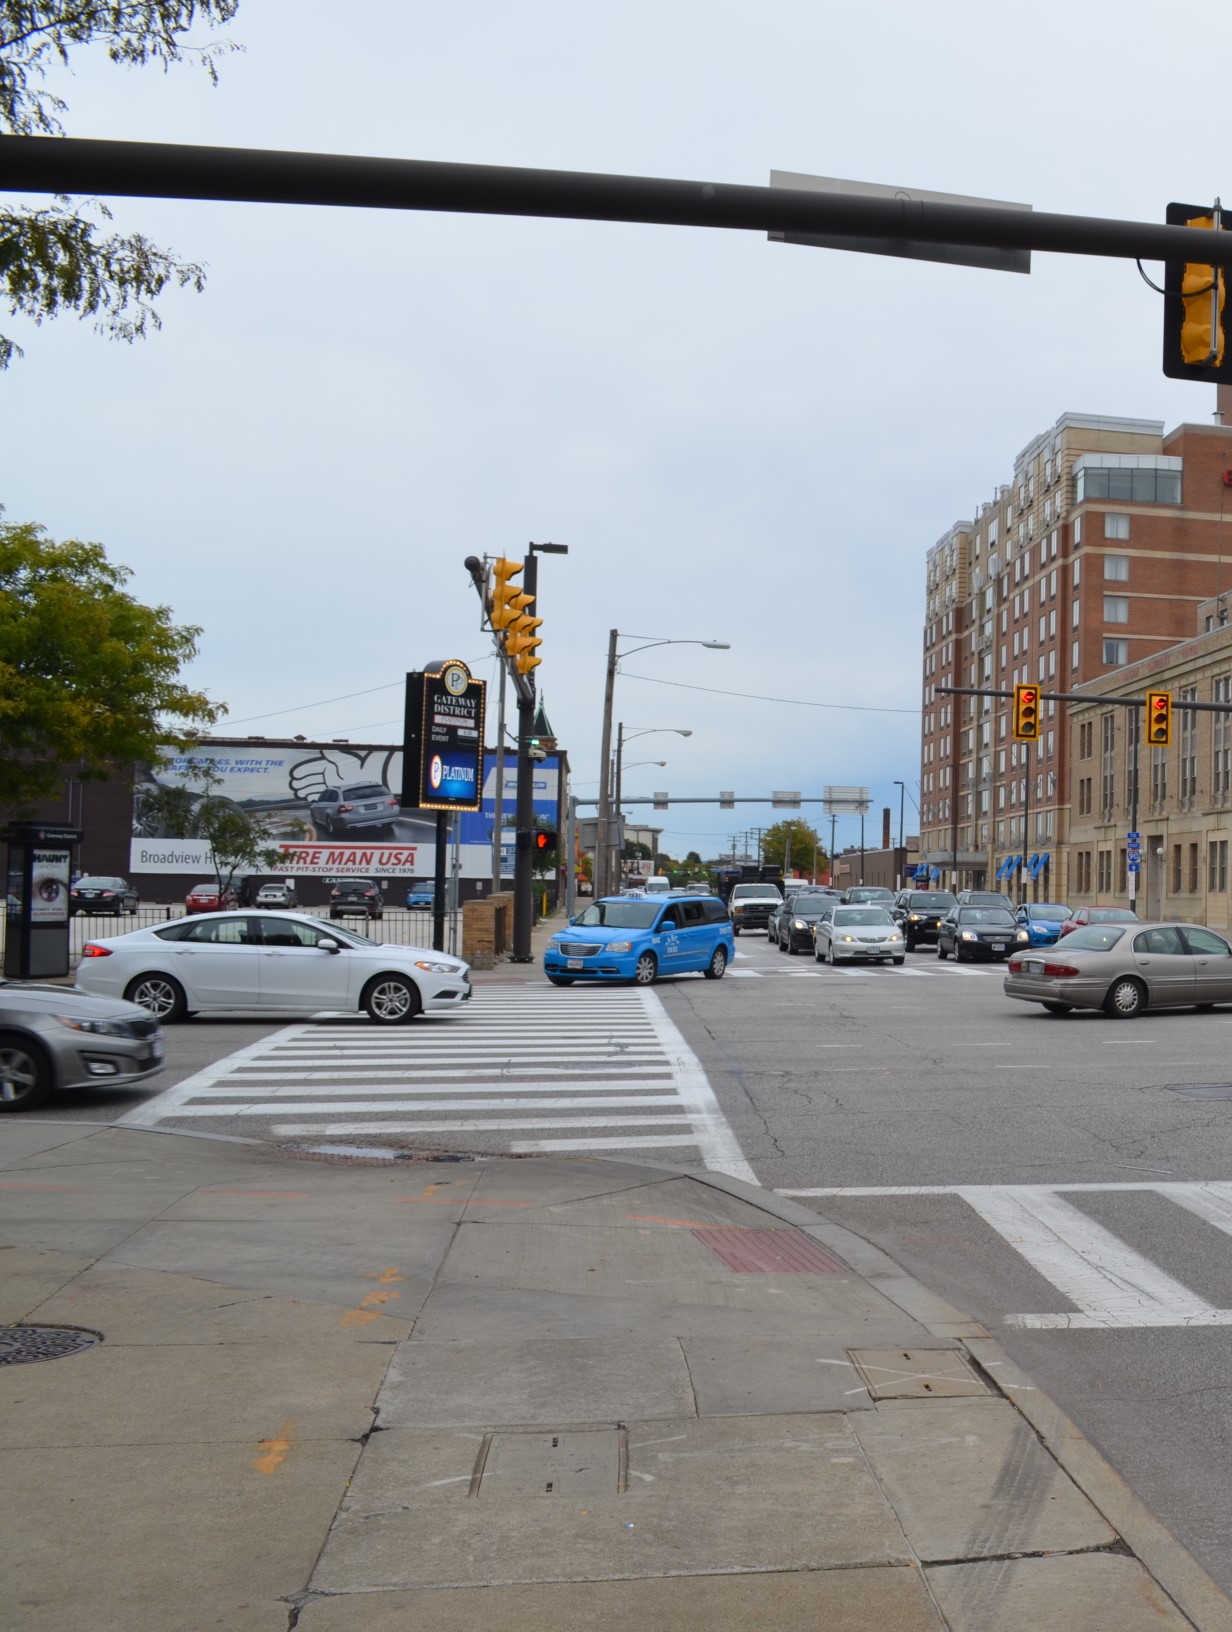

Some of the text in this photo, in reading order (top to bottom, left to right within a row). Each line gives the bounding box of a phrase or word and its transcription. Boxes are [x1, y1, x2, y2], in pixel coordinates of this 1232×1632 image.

[434, 694, 477, 708] GATEWAY
[434, 704, 476, 718] DISTRICT
[431, 725, 447, 733] DAILY
[431, 734, 450, 742] EVENT
[229, 766, 270, 774] EXPECT.
[442, 765, 474, 782] PLATINUM
[33, 854, 69, 864] HAUNT
[141, 851, 202, 864] Broadview
[279, 845, 415, 866] TIRE MAN USA
